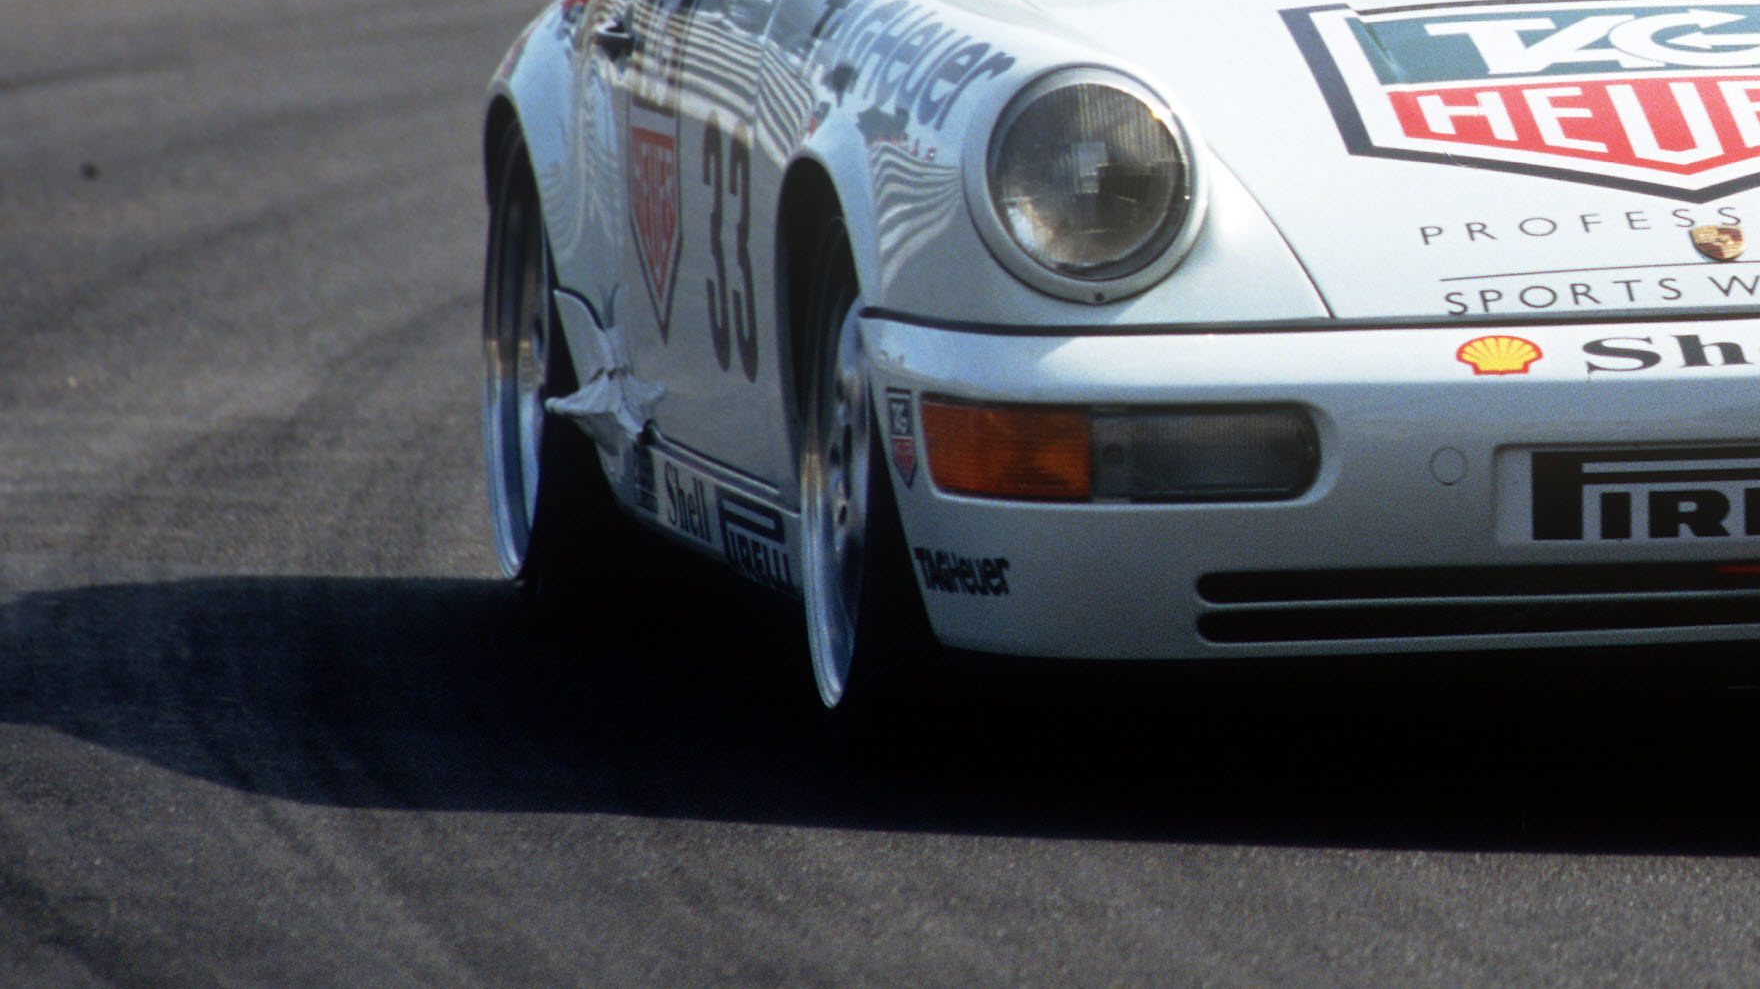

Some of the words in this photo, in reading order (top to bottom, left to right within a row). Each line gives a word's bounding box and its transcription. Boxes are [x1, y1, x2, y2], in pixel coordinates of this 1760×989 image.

[702, 108, 759, 384] 33
[1443, 276, 1683, 316] SPORTS
[664, 460, 713, 544] Shell
[715, 483, 794, 592] PIRELLI
